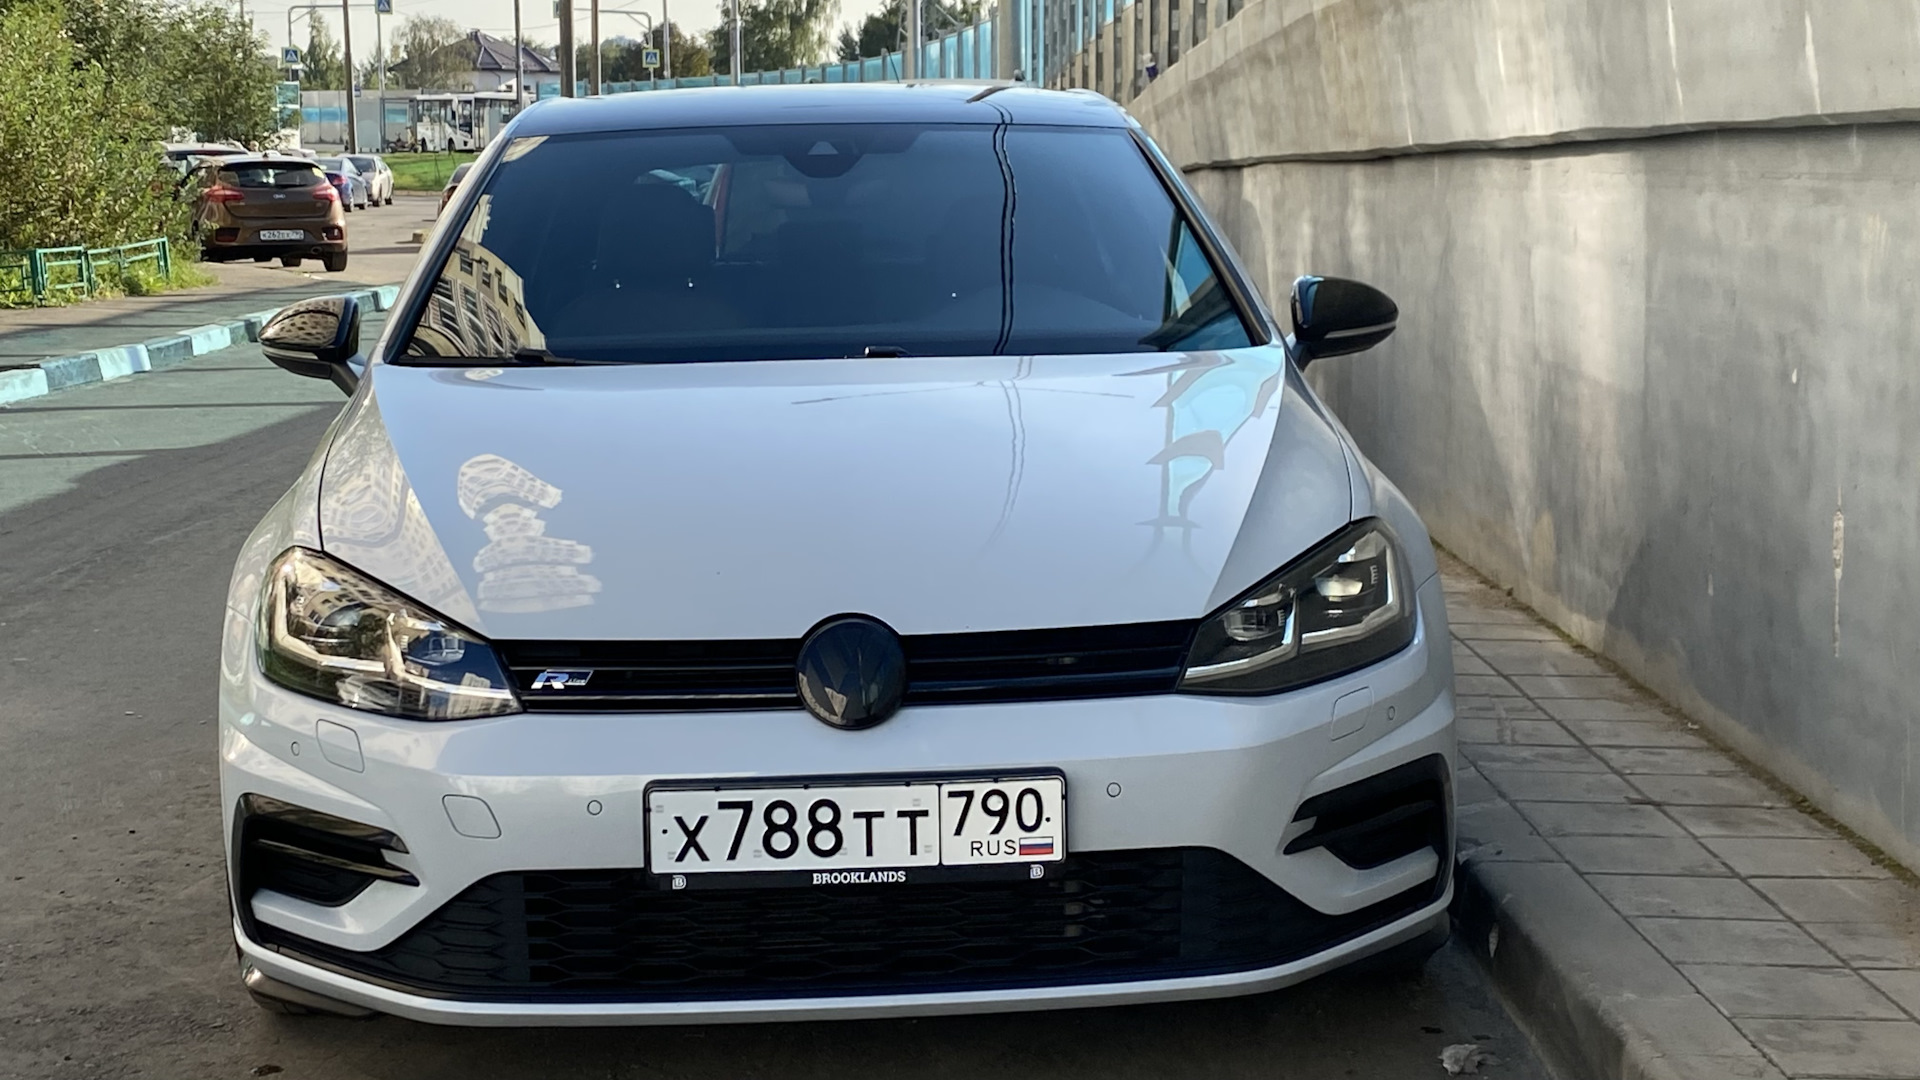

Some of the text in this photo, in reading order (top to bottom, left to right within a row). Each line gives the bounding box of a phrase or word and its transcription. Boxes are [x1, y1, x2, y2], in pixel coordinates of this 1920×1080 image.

[947, 787, 1043, 836] 790
[970, 839, 1018, 857] RUS
[812, 870, 906, 886] BROOKLANDS
